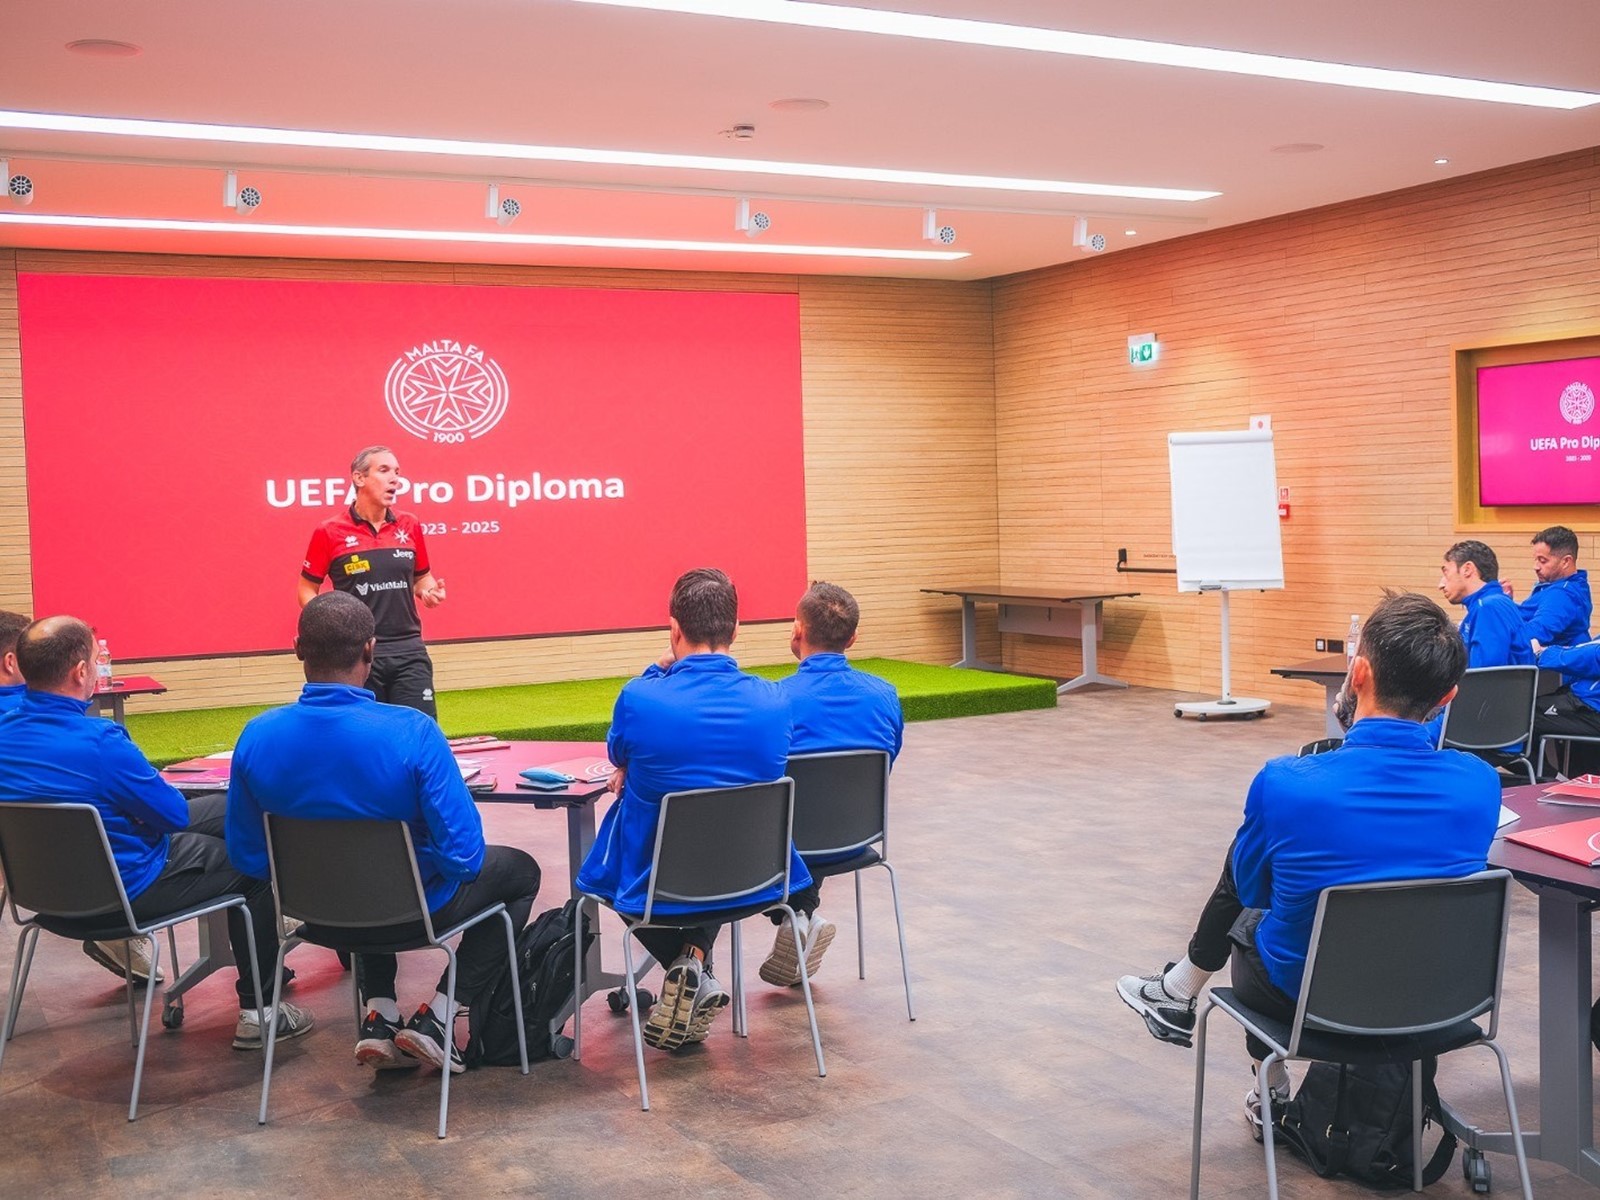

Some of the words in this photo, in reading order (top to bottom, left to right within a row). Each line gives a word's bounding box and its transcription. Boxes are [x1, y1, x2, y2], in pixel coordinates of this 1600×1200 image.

[404, 339, 462, 362] MALTA
[465, 344, 485, 362] FA
[433, 432, 465, 443] 1900
[1530, 437, 1558, 450] UEFA
[1560, 436, 1579, 449] Pro
[391, 477, 454, 504] Pro
[467, 471, 625, 508] Diploma
[420, 523, 447, 535] 023
[461, 521, 500, 534] 2025
[392, 549, 414, 560] Jeep
